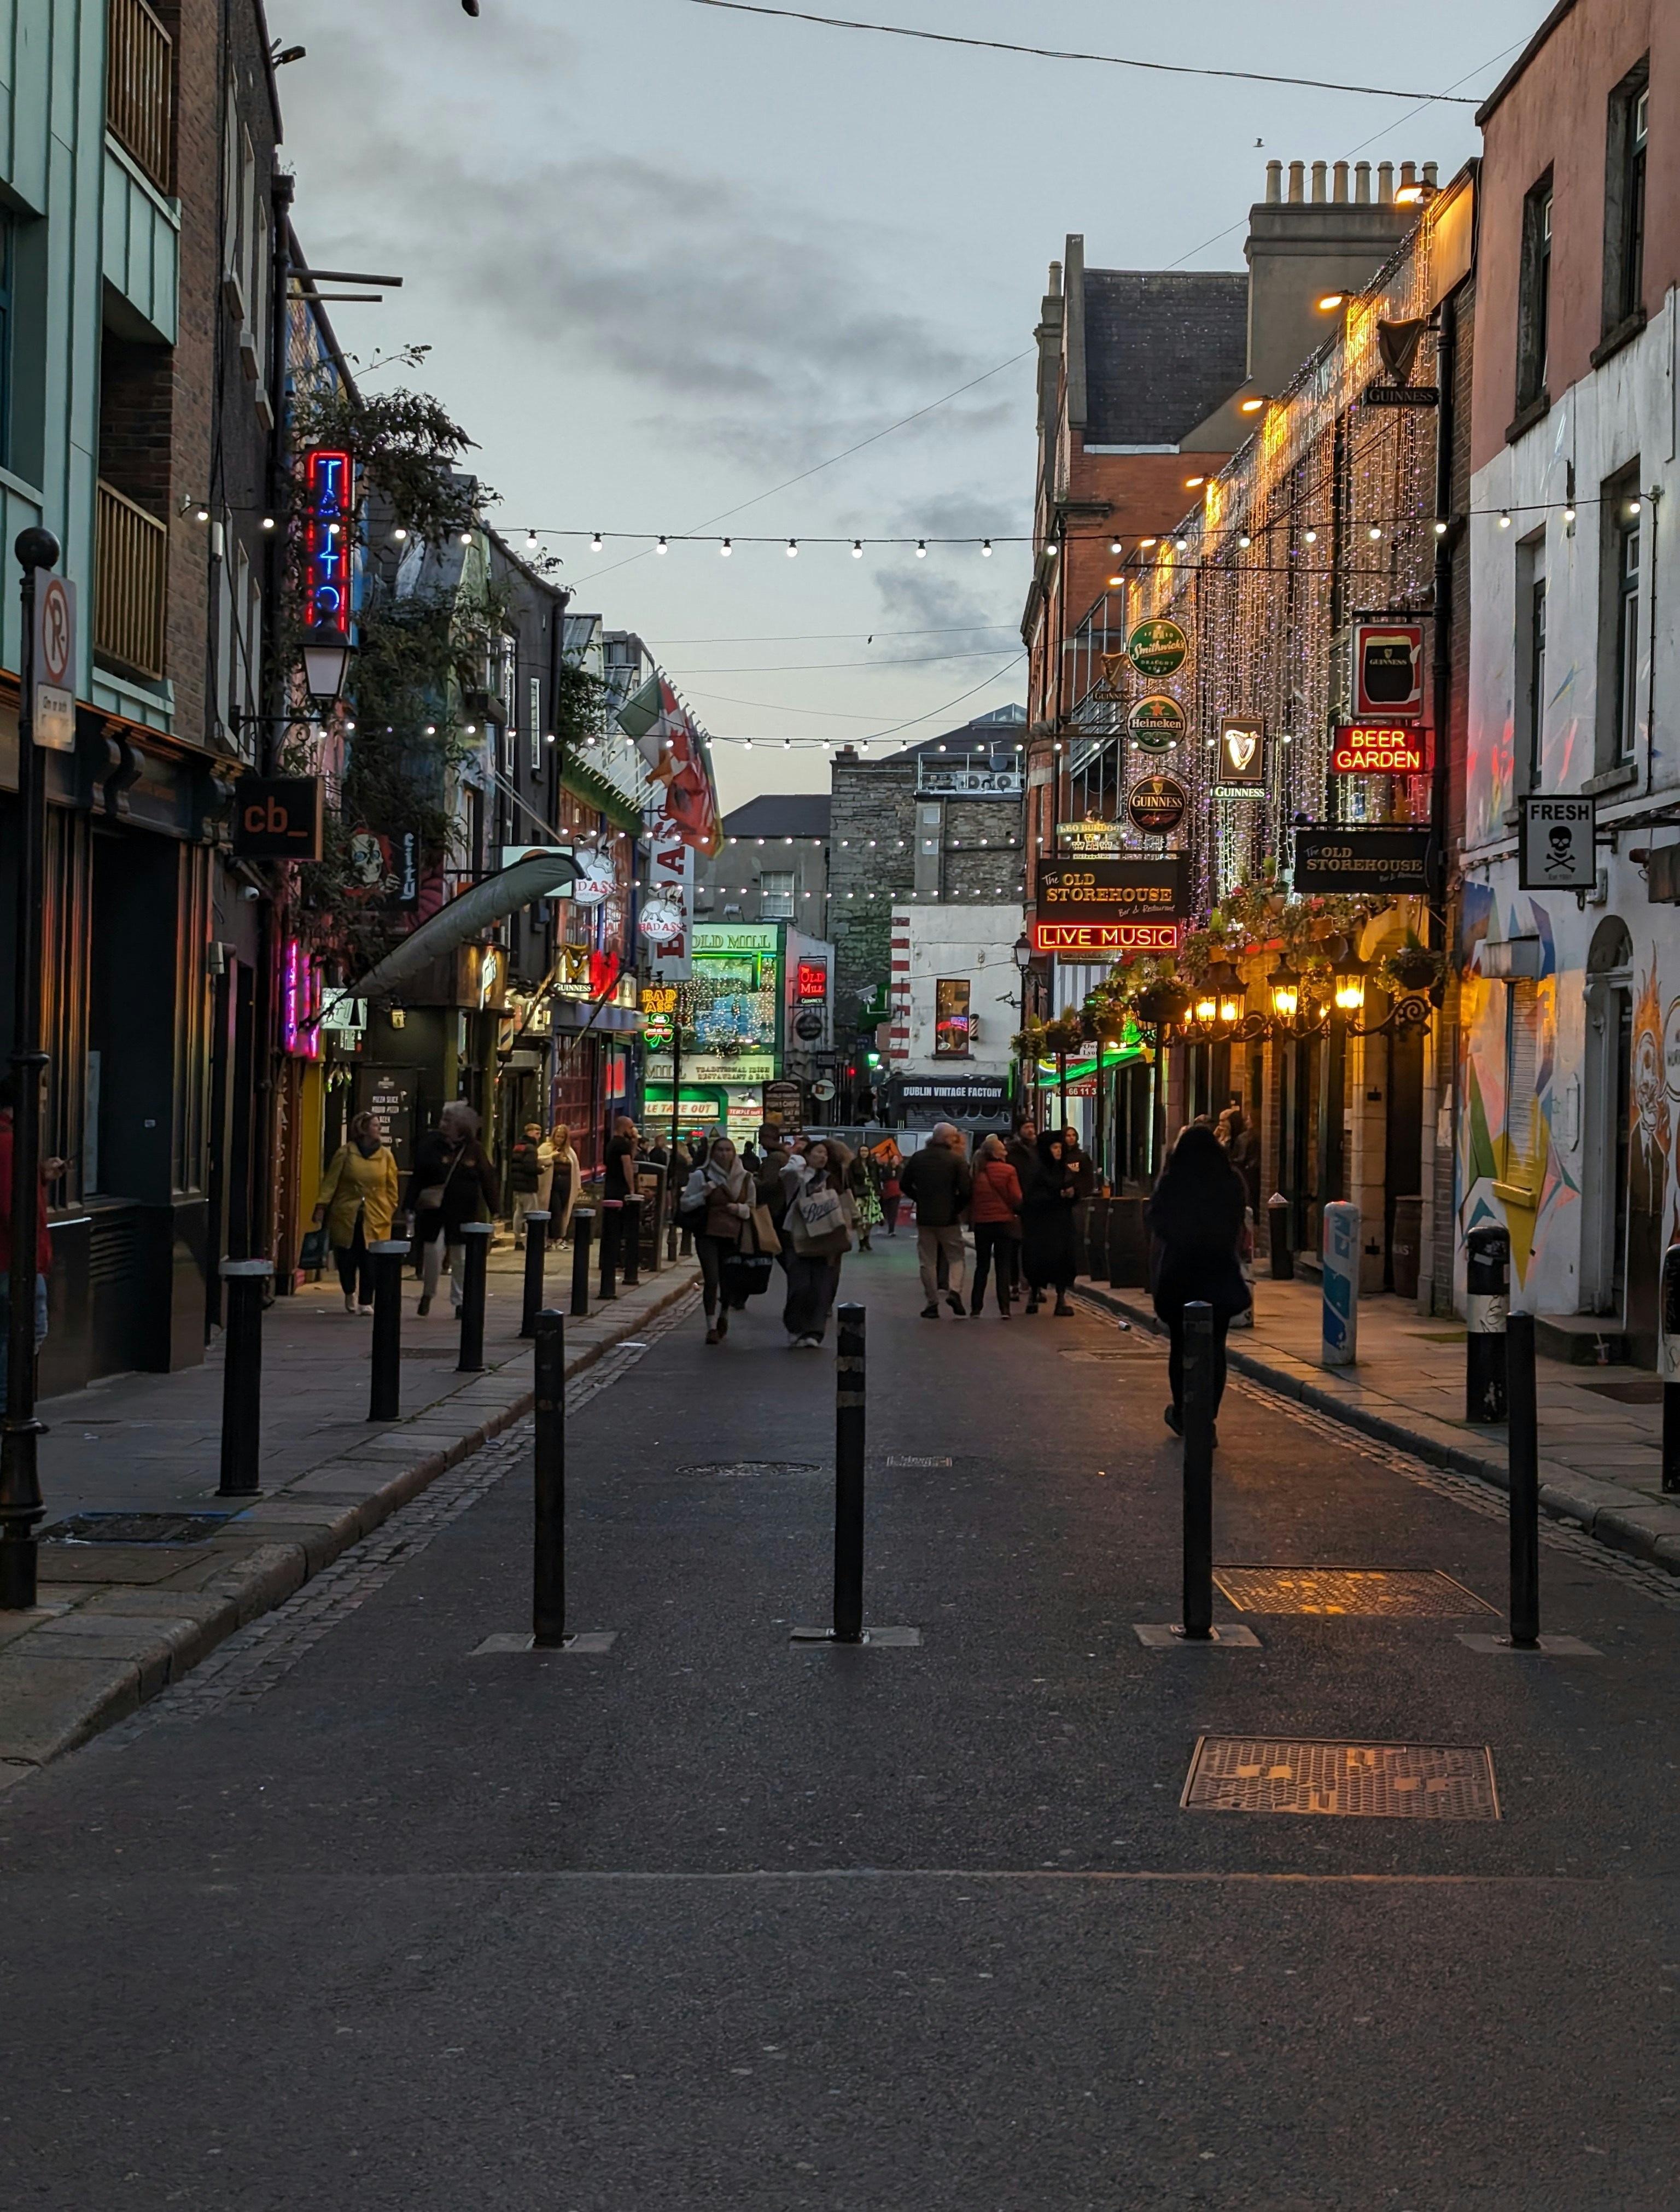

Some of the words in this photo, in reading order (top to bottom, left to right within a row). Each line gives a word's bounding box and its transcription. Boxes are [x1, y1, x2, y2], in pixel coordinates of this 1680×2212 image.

[1369, 388, 1434, 402] GUINNESS
[1131, 639, 1185, 661] Smithwick's
[1131, 719, 1182, 728] Heineken
[1351, 731, 1405, 748] BEER
[1337, 751, 1420, 768] GARDEN
[1215, 786, 1265, 797] GUINNESS
[1133, 796, 1182, 808] GUINNESS
[1531, 804, 1589, 820] FRESH
[1060, 825, 1079, 833] LEO
[1321, 847, 1353, 858] OLD
[1306, 859, 1423, 872] STOREHOUSE
[1042, 872, 1060, 886] The
[1062, 873, 1095, 886] OLD
[1046, 888, 1172, 902] STOREHOUSE
[1118, 908, 1130, 918] Bar
[638, 922, 661, 932] BAD
[727, 935, 771, 949] MILL
[1043, 929, 1092, 945] LIVE
[1101, 929, 1173, 945] MUSIC
[801, 972, 825, 983] OLD
[553, 982, 592, 993] GUINNESS
[642, 989, 677, 1002] BAD
[645, 1001, 675, 1013] ASS
[903, 1086, 932, 1096] DUBLIN
[934, 1087, 966, 1096] VINTAGE
[967, 1087, 1002, 1098] FACTORY
[661, 1104, 687, 1113] TAE
[691, 1104, 711, 1113] OUT
